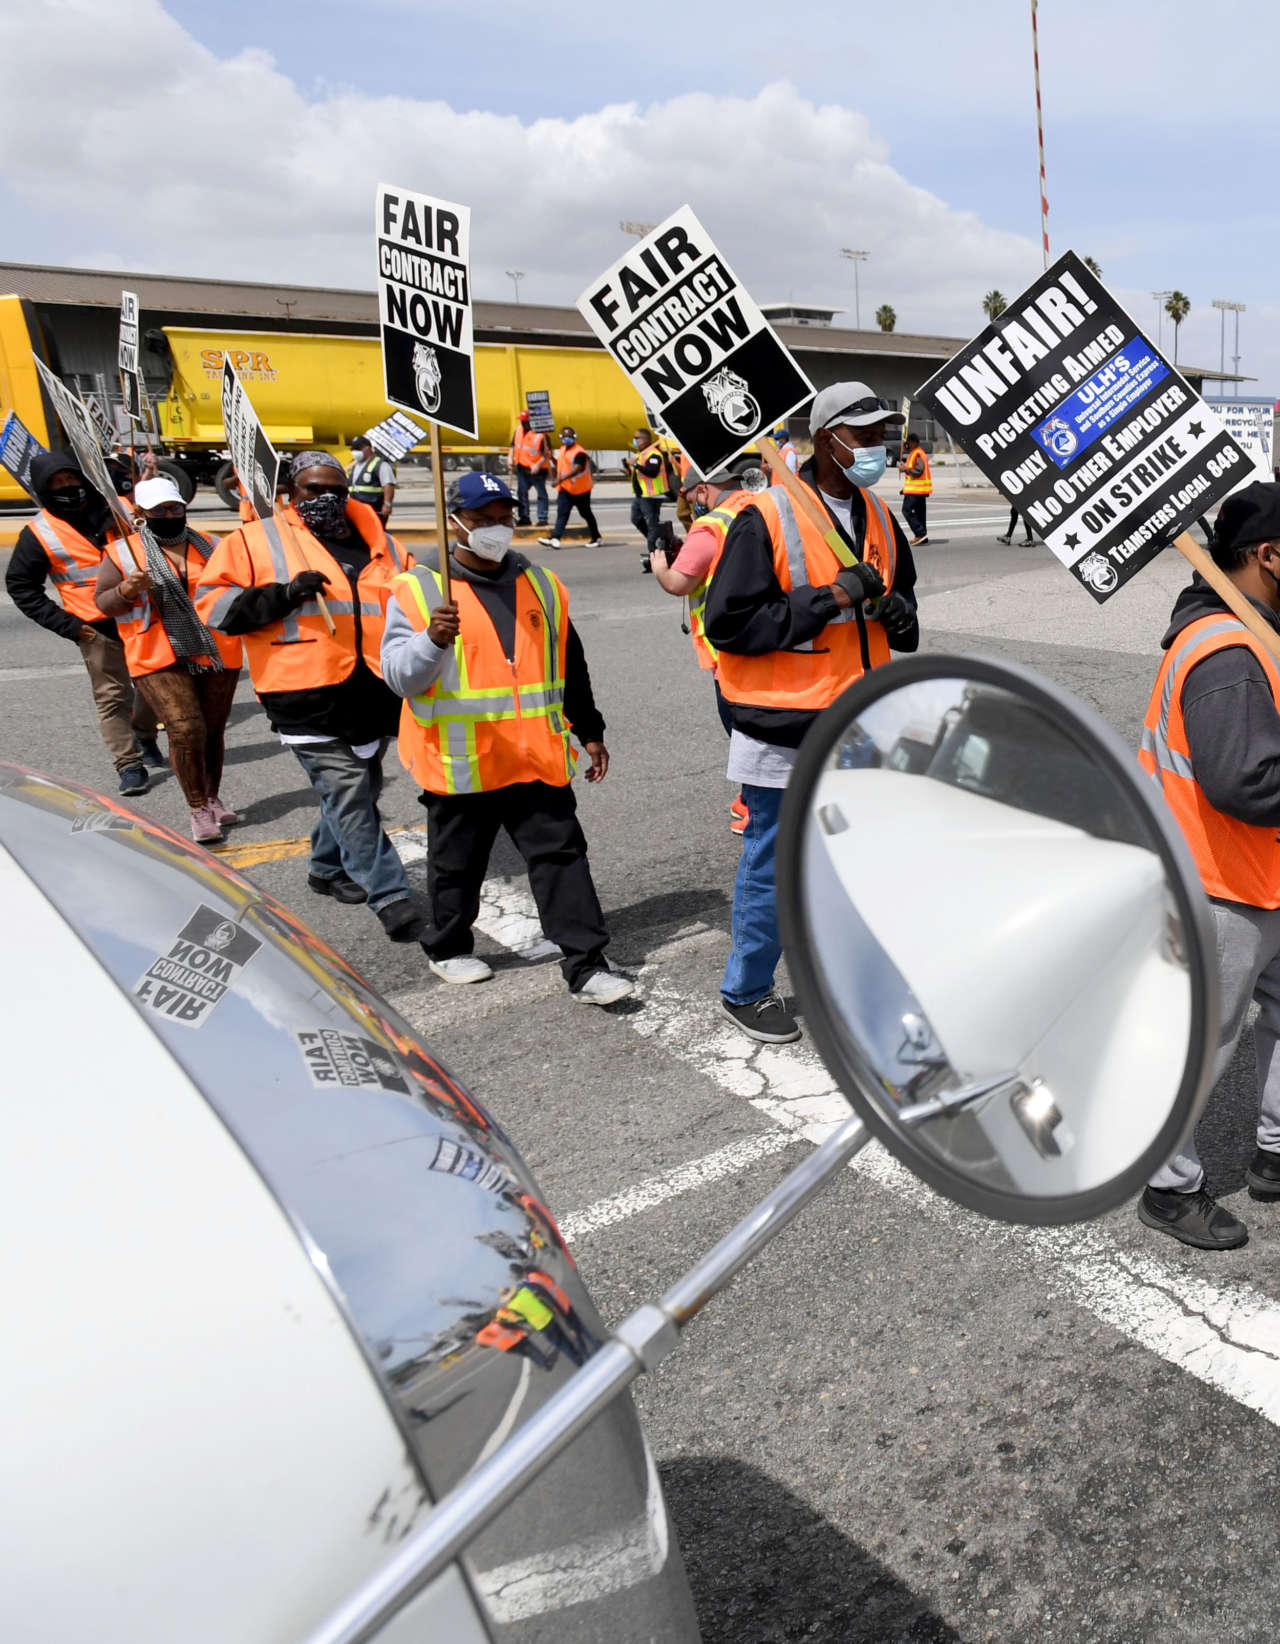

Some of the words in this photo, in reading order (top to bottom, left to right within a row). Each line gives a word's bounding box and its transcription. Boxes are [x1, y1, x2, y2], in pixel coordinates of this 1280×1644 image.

[384, 193, 460, 257] FAIR
[381, 244, 465, 301] CONTRACT
[590, 226, 702, 332] FAIR
[386, 284, 463, 348] NOW
[617, 261, 729, 367] CONTRACT
[200, 349, 272, 371] SPR
[641, 295, 750, 404] NOW
[935, 270, 1098, 426] UNFAIR!
[1075, 399, 1102, 423] Universal
[1099, 373, 1130, 402] Intermodal
[1128, 356, 1150, 376] Service
[1077, 356, 1130, 403] ULH'S
[1080, 420, 1092, 432] and
[1089, 400, 1115, 423] Southern
[1113, 379, 1138, 402] Counties
[1136, 360, 1159, 382] Express
[1098, 420, 1107, 428] as
[1108, 400, 1128, 418] Single
[1126, 378, 1152, 403] Employer
[1225, 419, 1273, 427] RECYCLNG
[1227, 406, 1244, 414] FOR
[1247, 430, 1270, 438] HEE
[480, 474, 500, 491] LA
[1081, 498, 1116, 535] ON
[1113, 435, 1188, 508] STRIKE
[1206, 445, 1239, 478] 848
